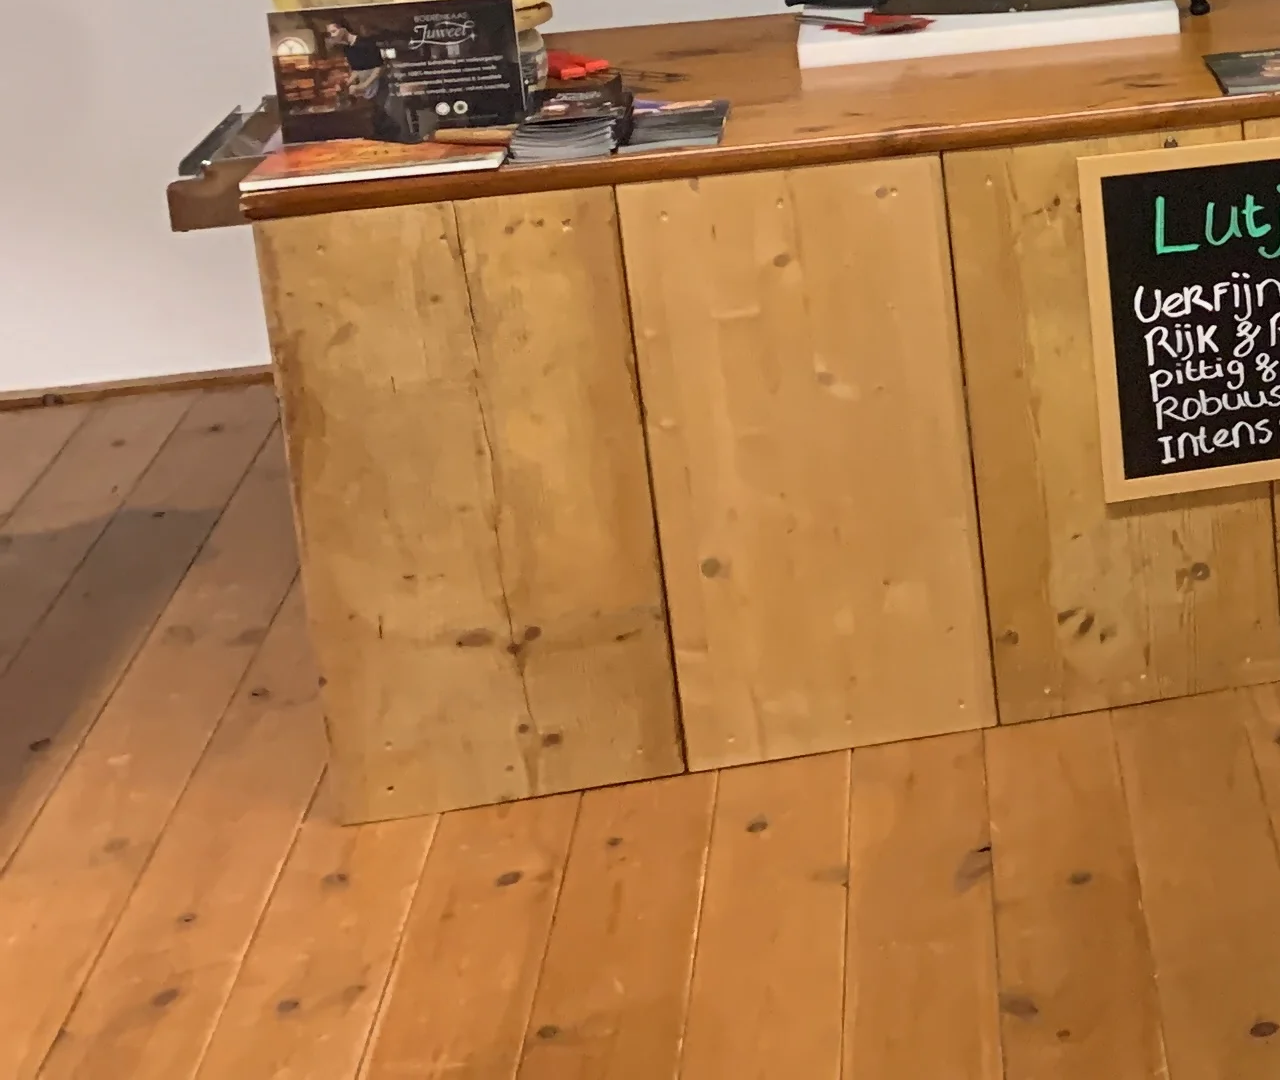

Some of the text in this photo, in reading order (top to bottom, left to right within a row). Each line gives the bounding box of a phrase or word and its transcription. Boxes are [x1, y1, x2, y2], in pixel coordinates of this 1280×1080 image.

[1233, 320, 1262, 358] &
[1255, 352, 1280, 383] &
[1157, 418, 1273, 465] Intens
